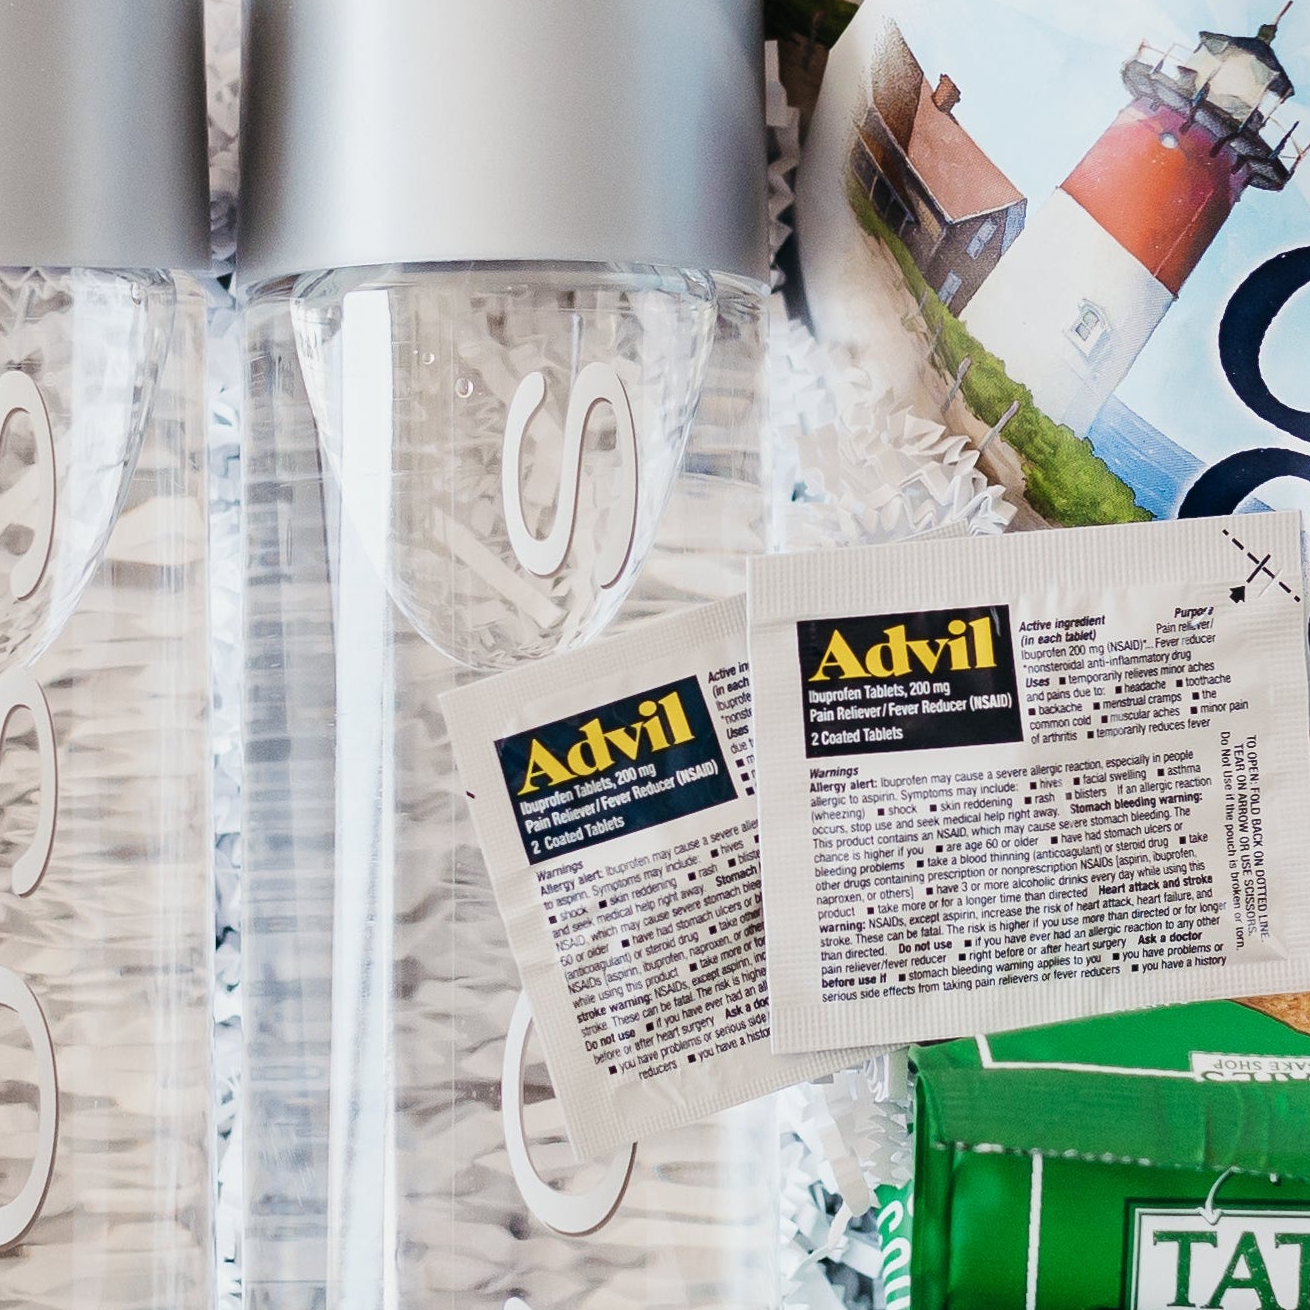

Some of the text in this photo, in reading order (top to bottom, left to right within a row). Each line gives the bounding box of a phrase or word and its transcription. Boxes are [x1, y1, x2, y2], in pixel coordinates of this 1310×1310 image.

[1018, 615, 1105, 632] Active ingredient
[1156, 622, 1176, 633] Pain
[807, 616, 997, 682] Advil
[1021, 629, 1096, 647] (in each tablet)
[1021, 647, 1066, 660] Ibuprofen
[1068, 644, 1086, 655] 200
[1089, 645, 1104, 656] mg
[1155, 637, 1179, 648] Fever
[1181, 634, 1215, 645] reducer
[1087, 653, 1170, 668] anti-inflammatory
[1171, 649, 1191, 661] drug
[1025, 661, 1214, 688] Uses temporarily relieves minor aches
[808, 681, 950, 705] Ibuprofen Tablets, 200 mg
[1026, 691, 1045, 702] and
[1046, 689, 1071, 702] pains
[1073, 688, 1090, 697] due
[1124, 679, 1166, 693] headache
[1185, 674, 1231, 686] toothache
[809, 693, 1012, 722] Pain Reliever/Fever Reducer (NSAID)
[1038, 689, 1216, 714] backache menstrual cramps the
[1029, 700, 1248, 730] common cold muscular aches minor pain
[516, 691, 695, 796] Advil
[811, 726, 903, 746] 2 Coated Tablets
[1031, 718, 1210, 744] of arthritis temporarily reduces fever
[1220, 731, 1230, 745] Do
[1221, 748, 1231, 767] Not
[809, 782, 846, 794] Allergy
[850, 778, 877, 790] alert:
[881, 775, 927, 787] Ibuprofen
[931, 775, 951, 784] may
[954, 772, 983, 781] cause
[996, 768, 1027, 777] severe
[1030, 763, 1063, 776] allergic
[1065, 760, 1103, 772] reaction,
[1105, 754, 1150, 769] especially
[1152, 753, 1161, 763] in
[1163, 749, 1193, 764] people
[809, 766, 858, 779] Warnings
[1223, 770, 1233, 790] Use
[519, 764, 657, 815] Ibuprofen Tablets, 200 mg
[1225, 803, 1235, 820] the
[531, 816, 625, 854] 2 Coated Tablets
[1224, 824, 1237, 856] pouch
[1234, 743, 1257, 936] TEAR ON ARROW OR USE SCISSORS.
[1246, 735, 1270, 941] TO OPEN: FOLD BACK ON DOTTED LINE.
[1230, 859, 1238, 869] is
[1231, 871, 1241, 908] broken
[1234, 912, 1242, 922] or
[1235, 926, 1244, 950] torn.
[1213, 1060, 1261, 1071] SHOP
